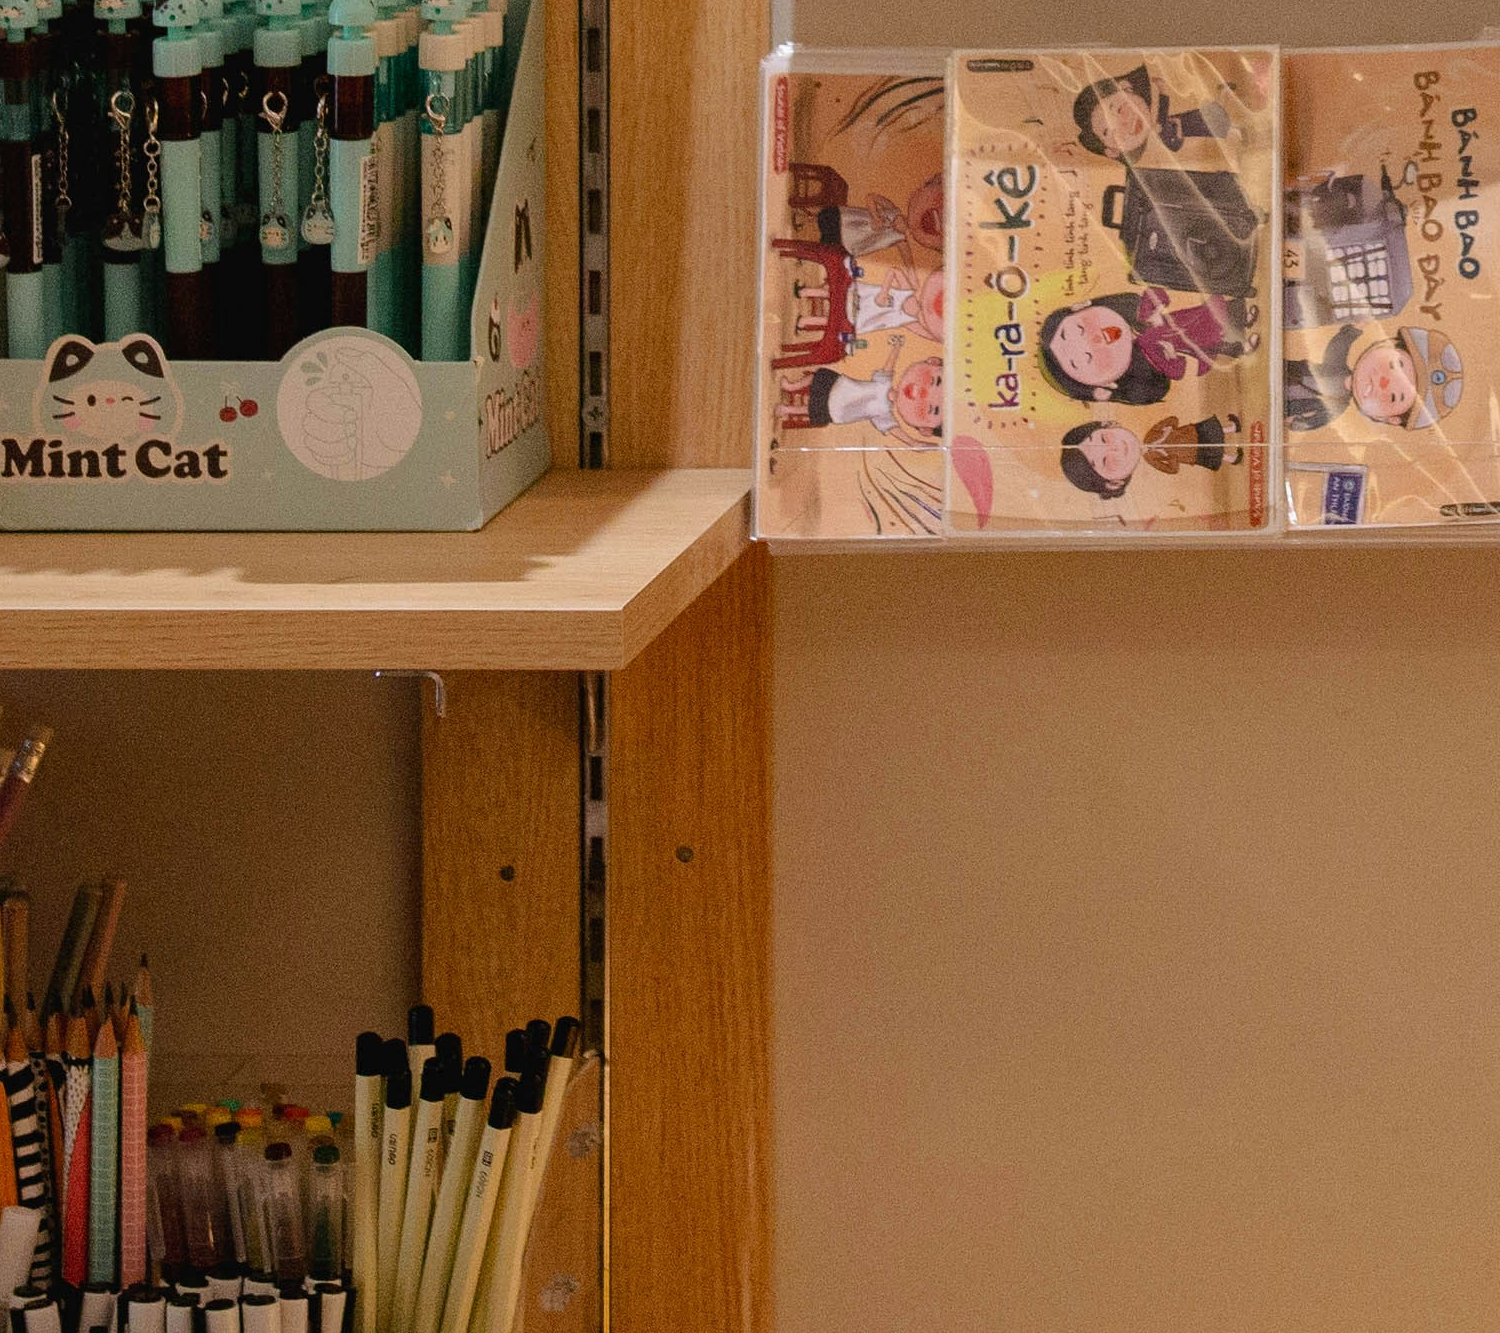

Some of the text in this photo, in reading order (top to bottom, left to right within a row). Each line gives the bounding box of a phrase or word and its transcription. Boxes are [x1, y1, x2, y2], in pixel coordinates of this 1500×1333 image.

[1416, 171, 1444, 243] BAO
[1451, 107, 1482, 280] BÁNH BAO
[0, 437, 229, 480] Mint Cat
